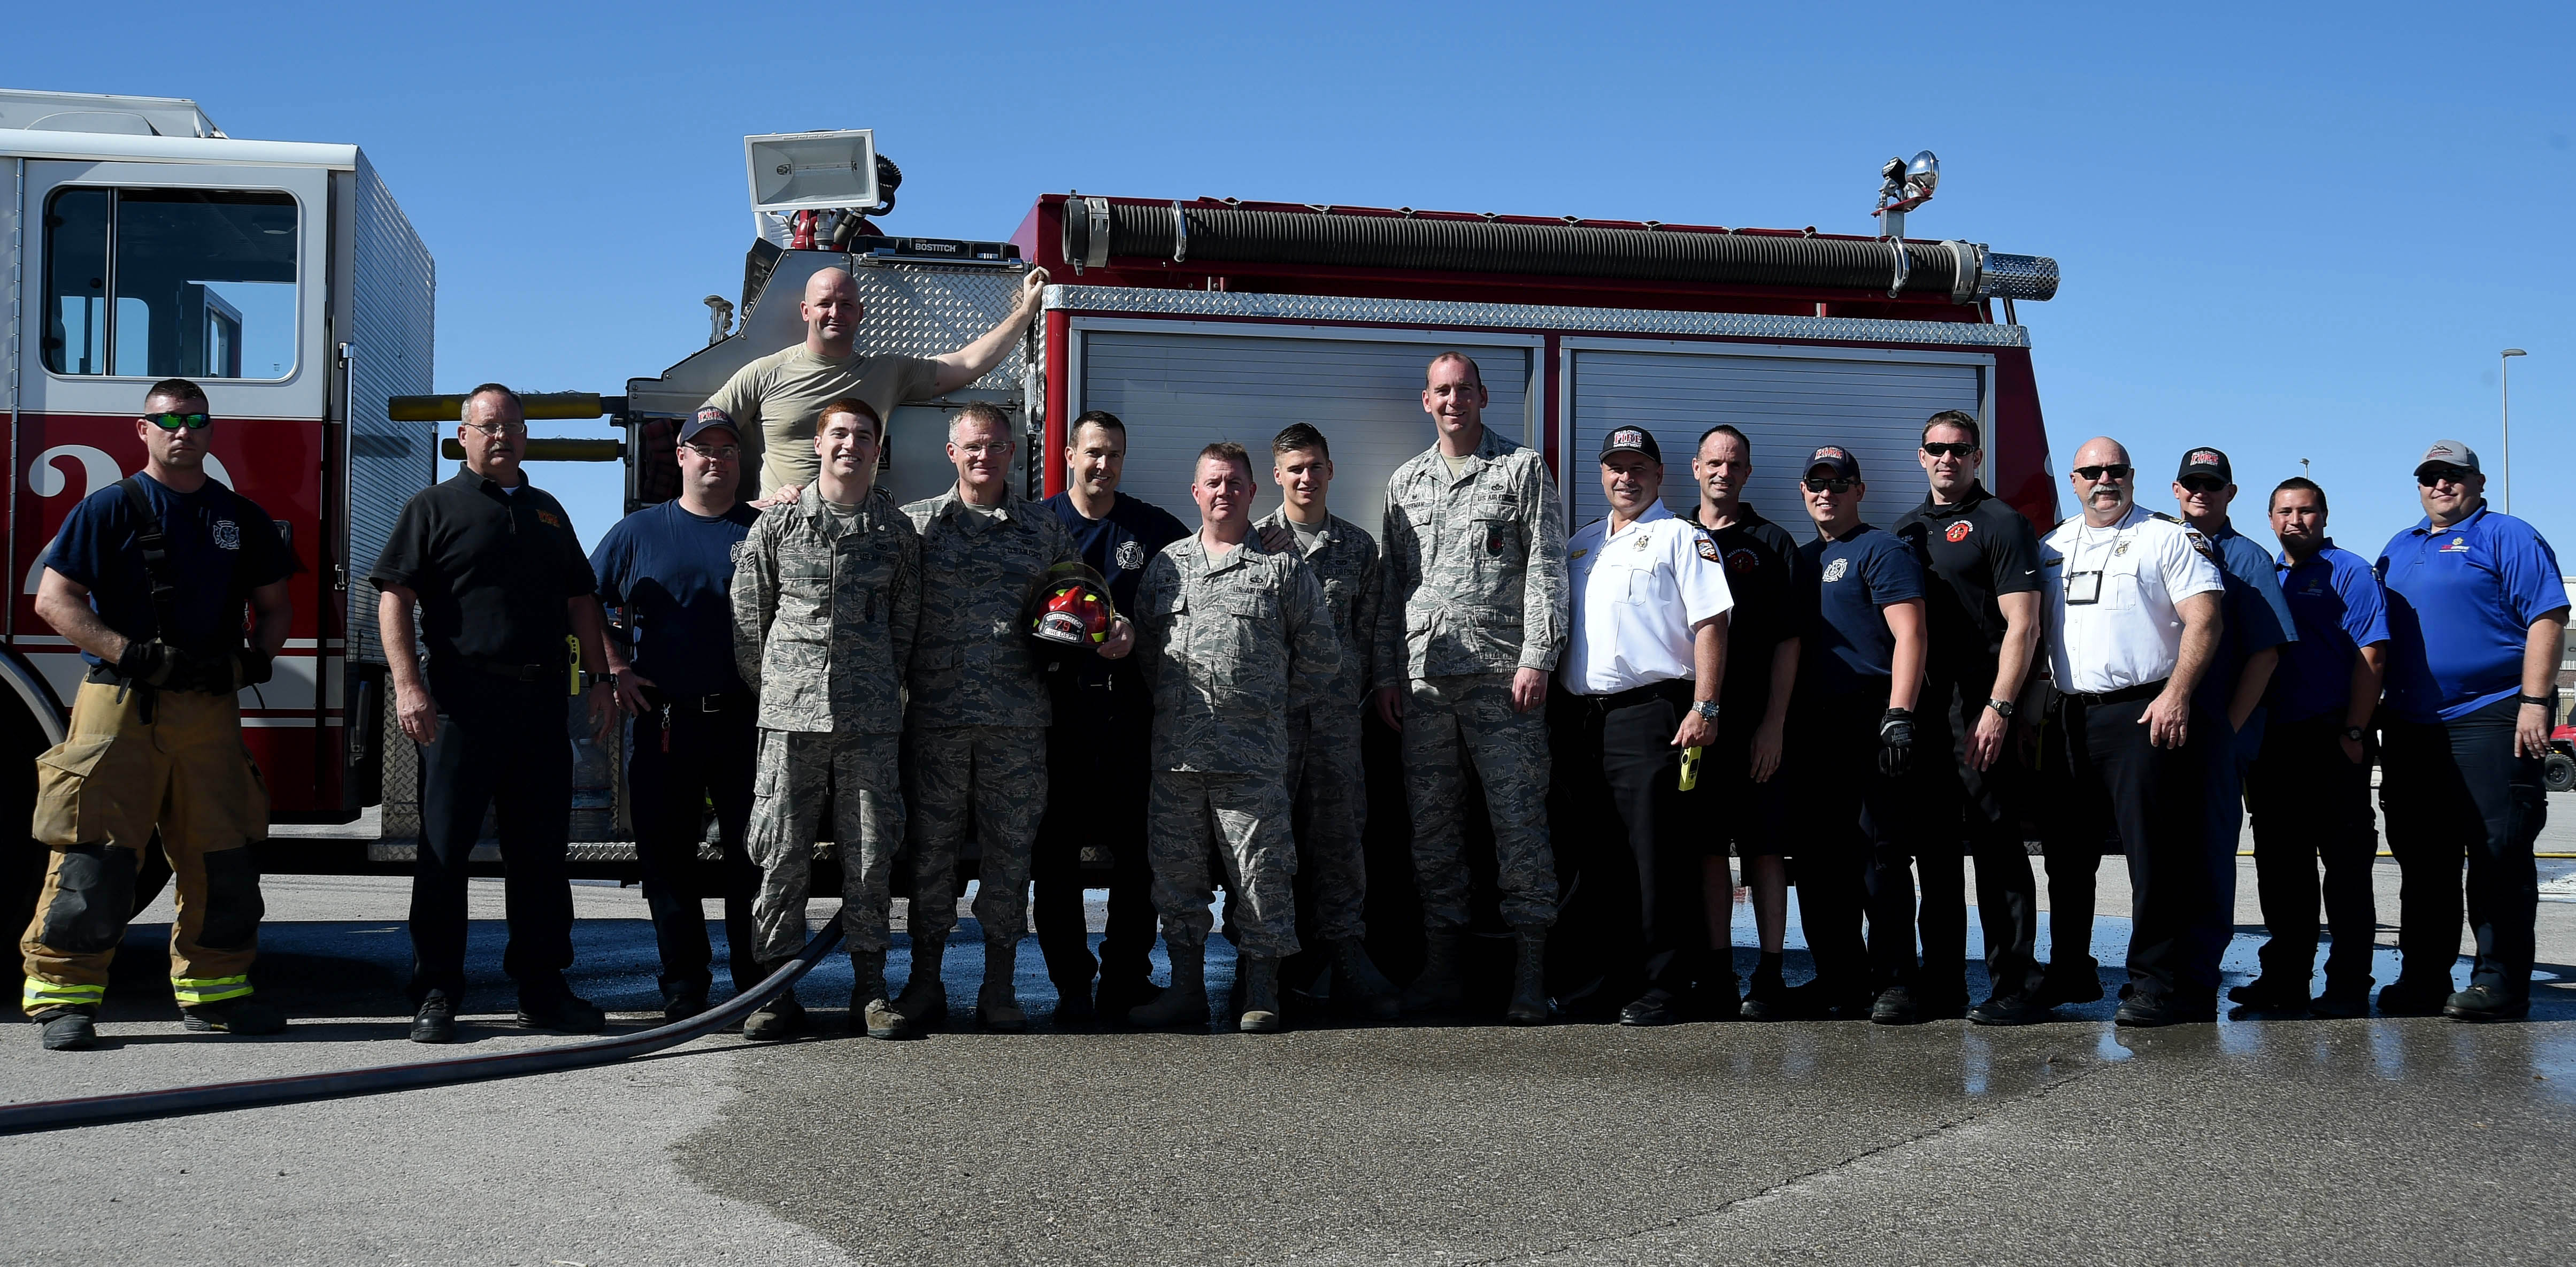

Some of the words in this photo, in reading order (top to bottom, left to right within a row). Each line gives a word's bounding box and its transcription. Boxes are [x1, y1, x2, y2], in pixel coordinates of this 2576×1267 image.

[915, 243, 956, 252] BOSTITCH
[698, 411, 726, 420] FIRE
[1614, 434, 1642, 444] FIRE
[1817, 450, 1842, 458] FIRE
[2191, 454, 2218, 463] FIRE
[1048, 613, 1083, 628] NELLIS-CREECH
[1055, 620, 1070, 632] 79
[1060, 632, 1077, 640] DEPT
